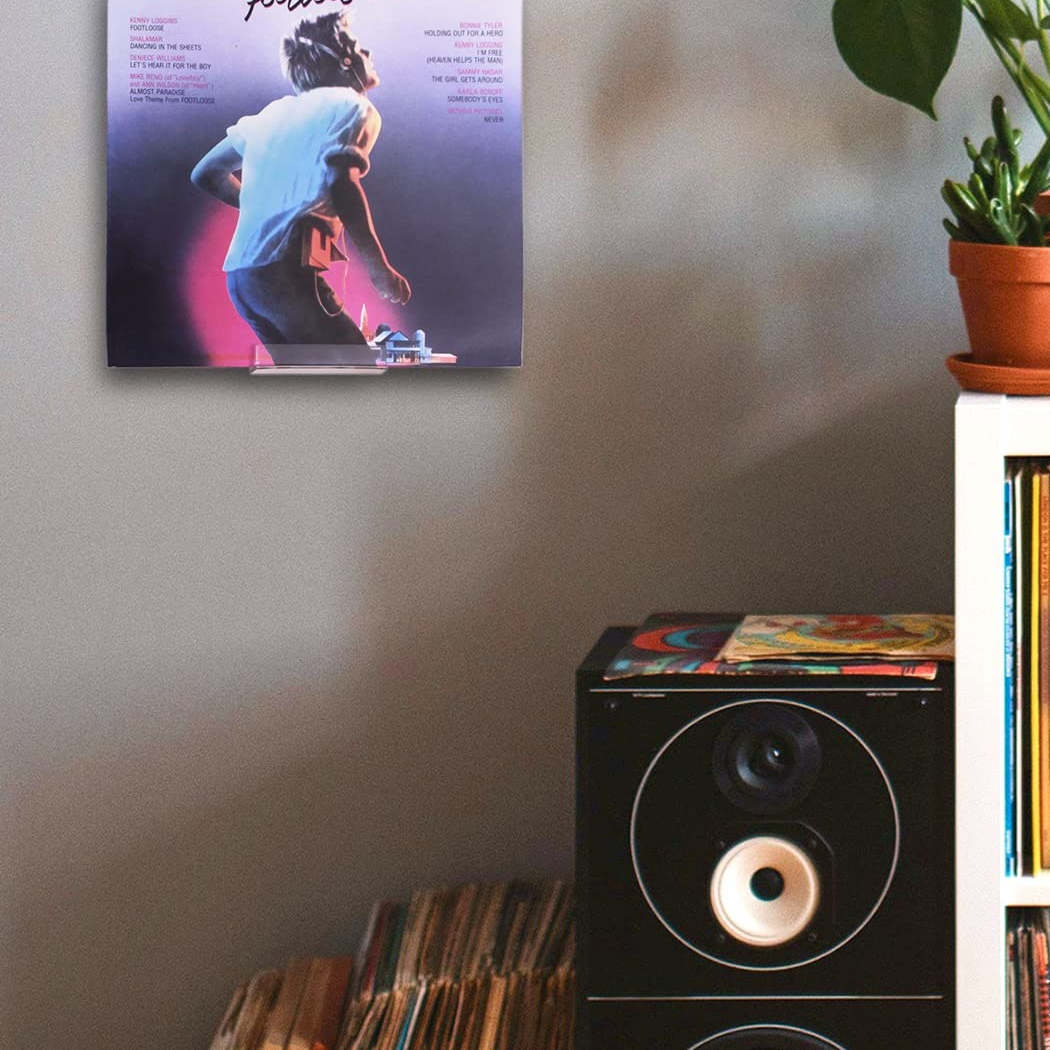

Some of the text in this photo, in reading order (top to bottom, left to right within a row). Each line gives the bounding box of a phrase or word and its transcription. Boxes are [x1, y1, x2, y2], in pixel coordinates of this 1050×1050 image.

[426, 56, 504, 65] (HEAVEN HELPS THE MAN)
